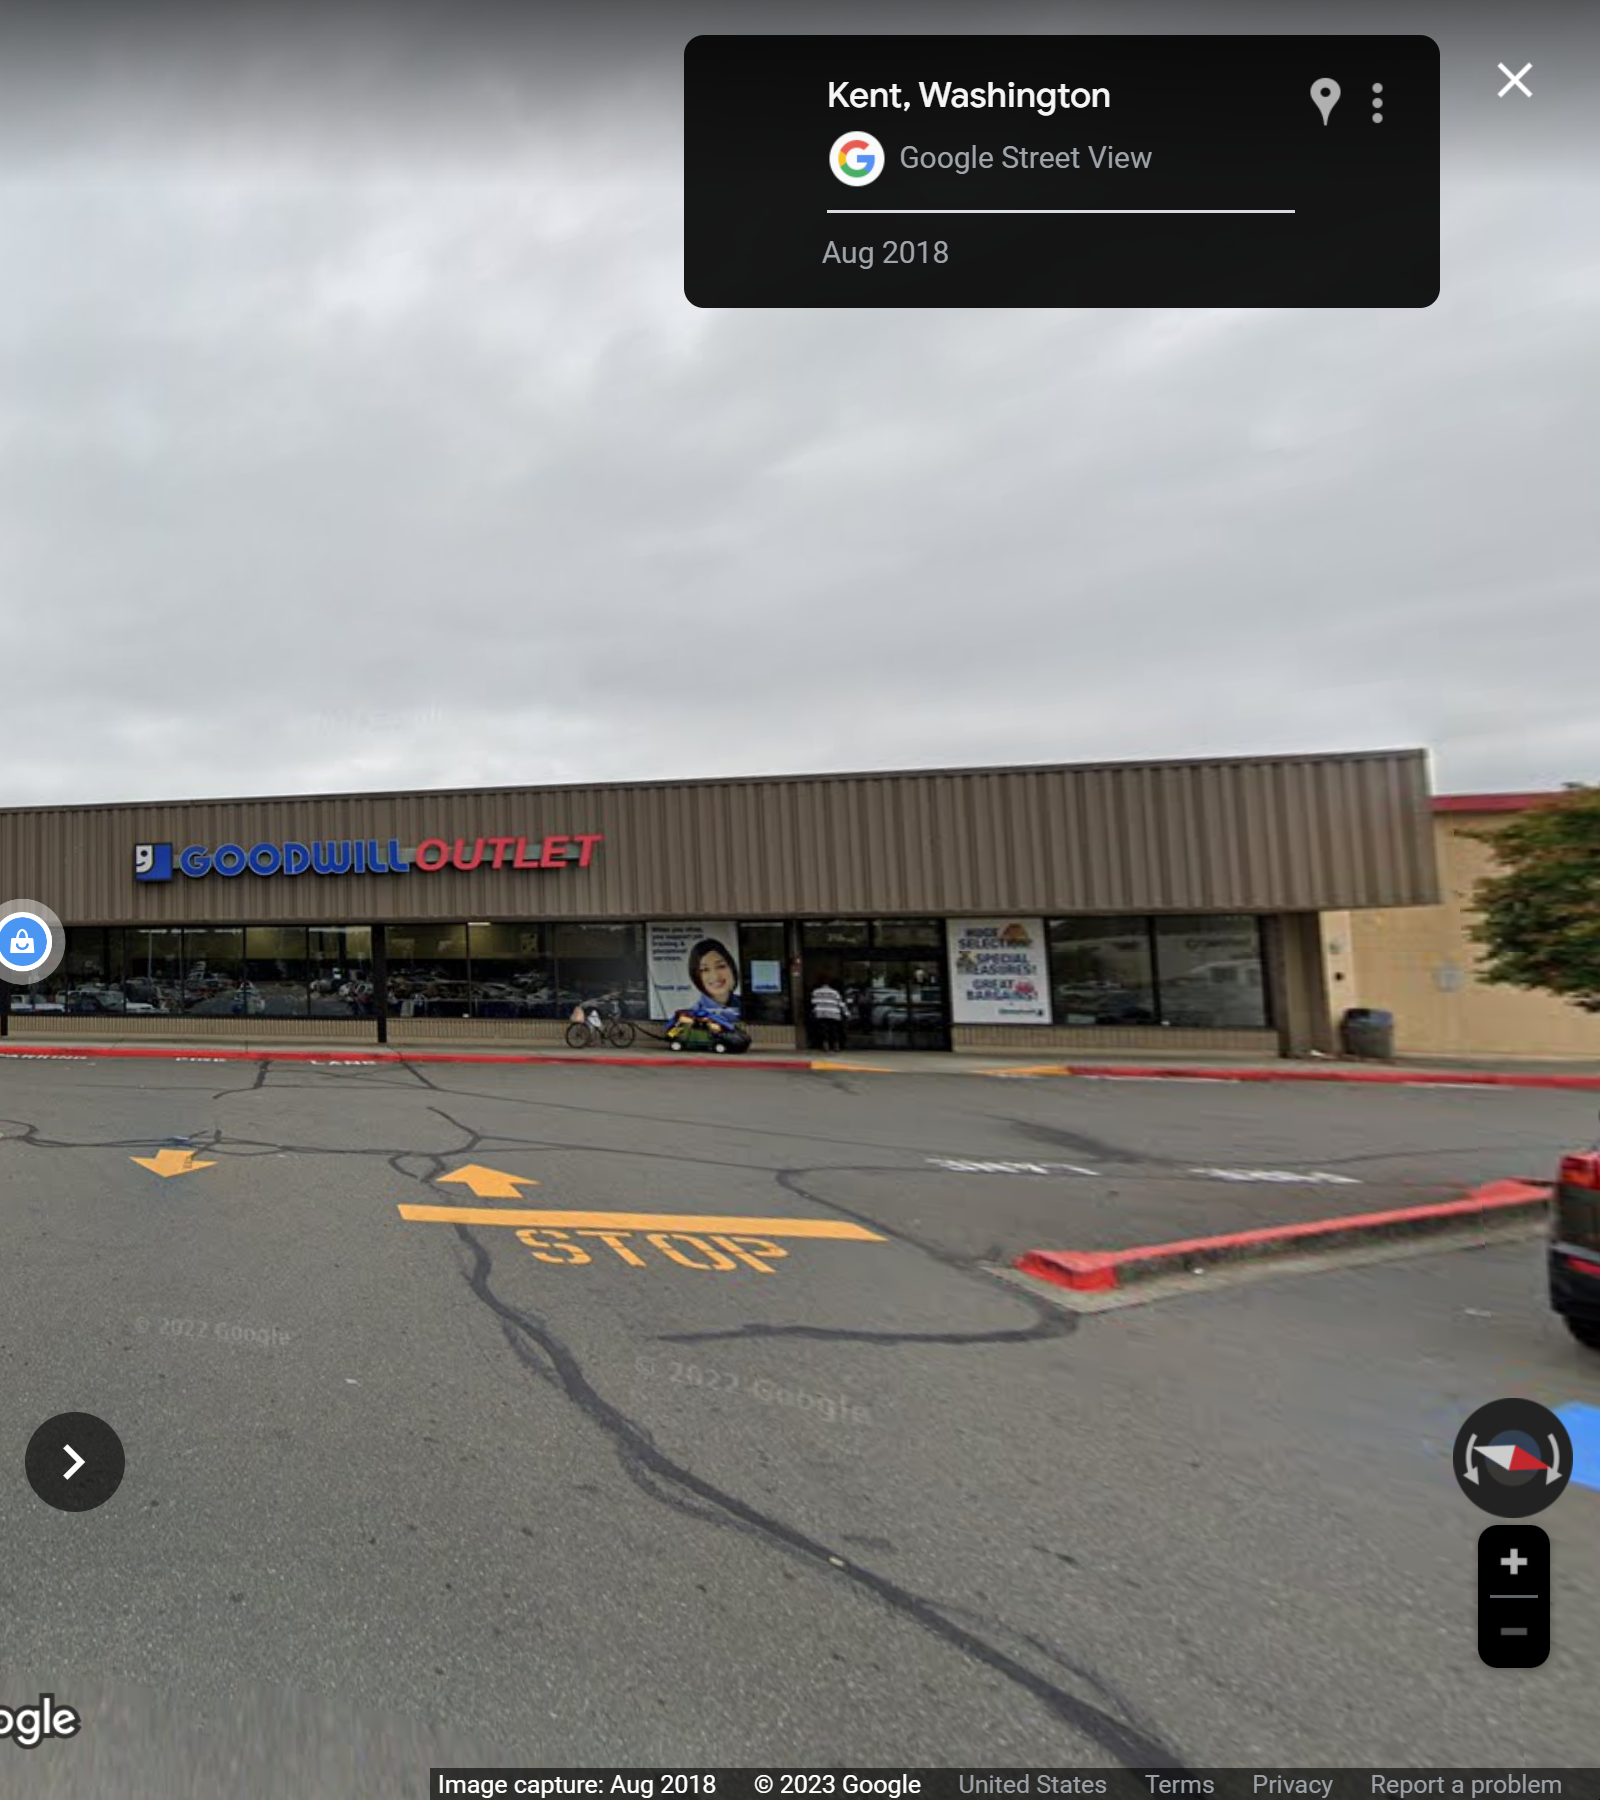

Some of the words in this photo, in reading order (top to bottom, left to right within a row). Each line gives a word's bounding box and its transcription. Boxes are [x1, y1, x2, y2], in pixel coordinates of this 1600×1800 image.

[178, 838, 410, 877] GOODWILL
[414, 833, 604, 871] OUTLET
[514, 1228, 790, 1274] STOP
